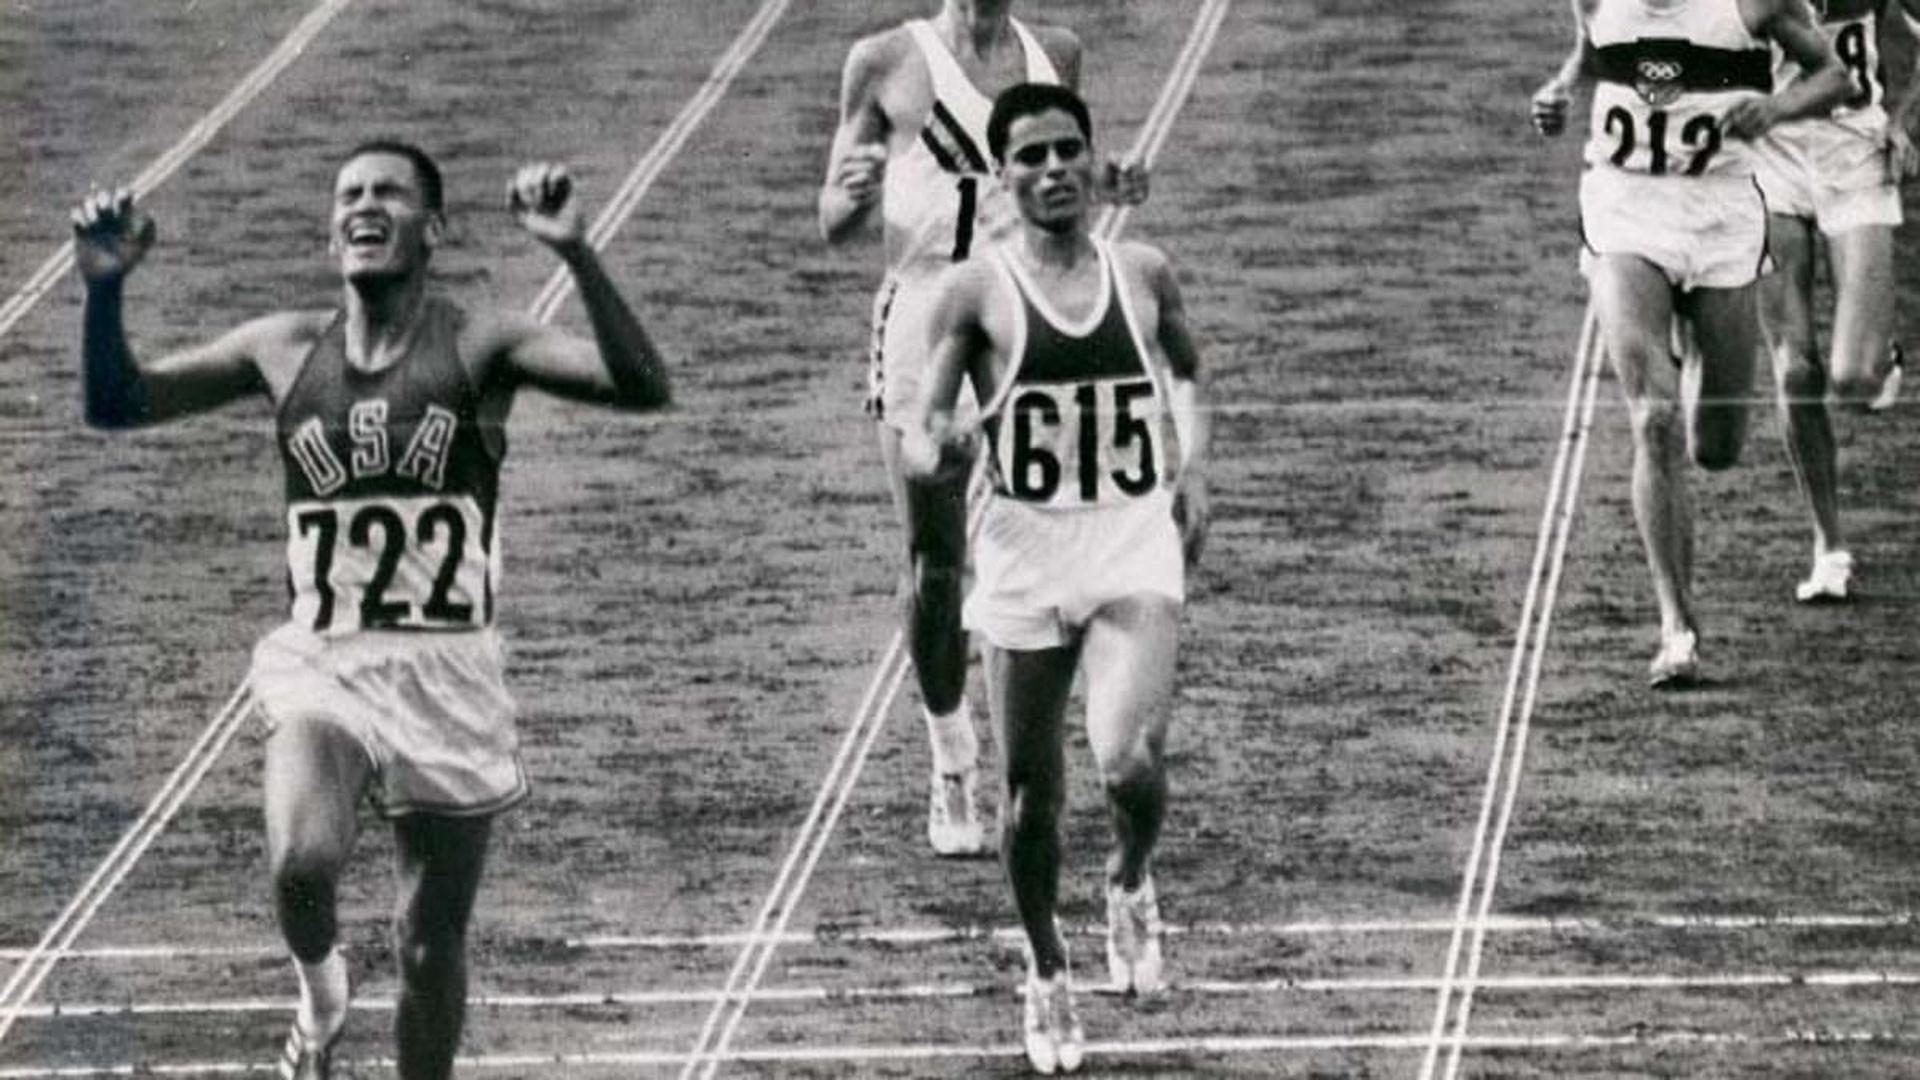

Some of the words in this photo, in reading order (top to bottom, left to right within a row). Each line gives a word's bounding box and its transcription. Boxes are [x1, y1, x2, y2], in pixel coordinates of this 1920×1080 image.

[288, 400, 457, 496] USA
[1012, 381, 1157, 502] 615
[298, 505, 474, 632] 722
